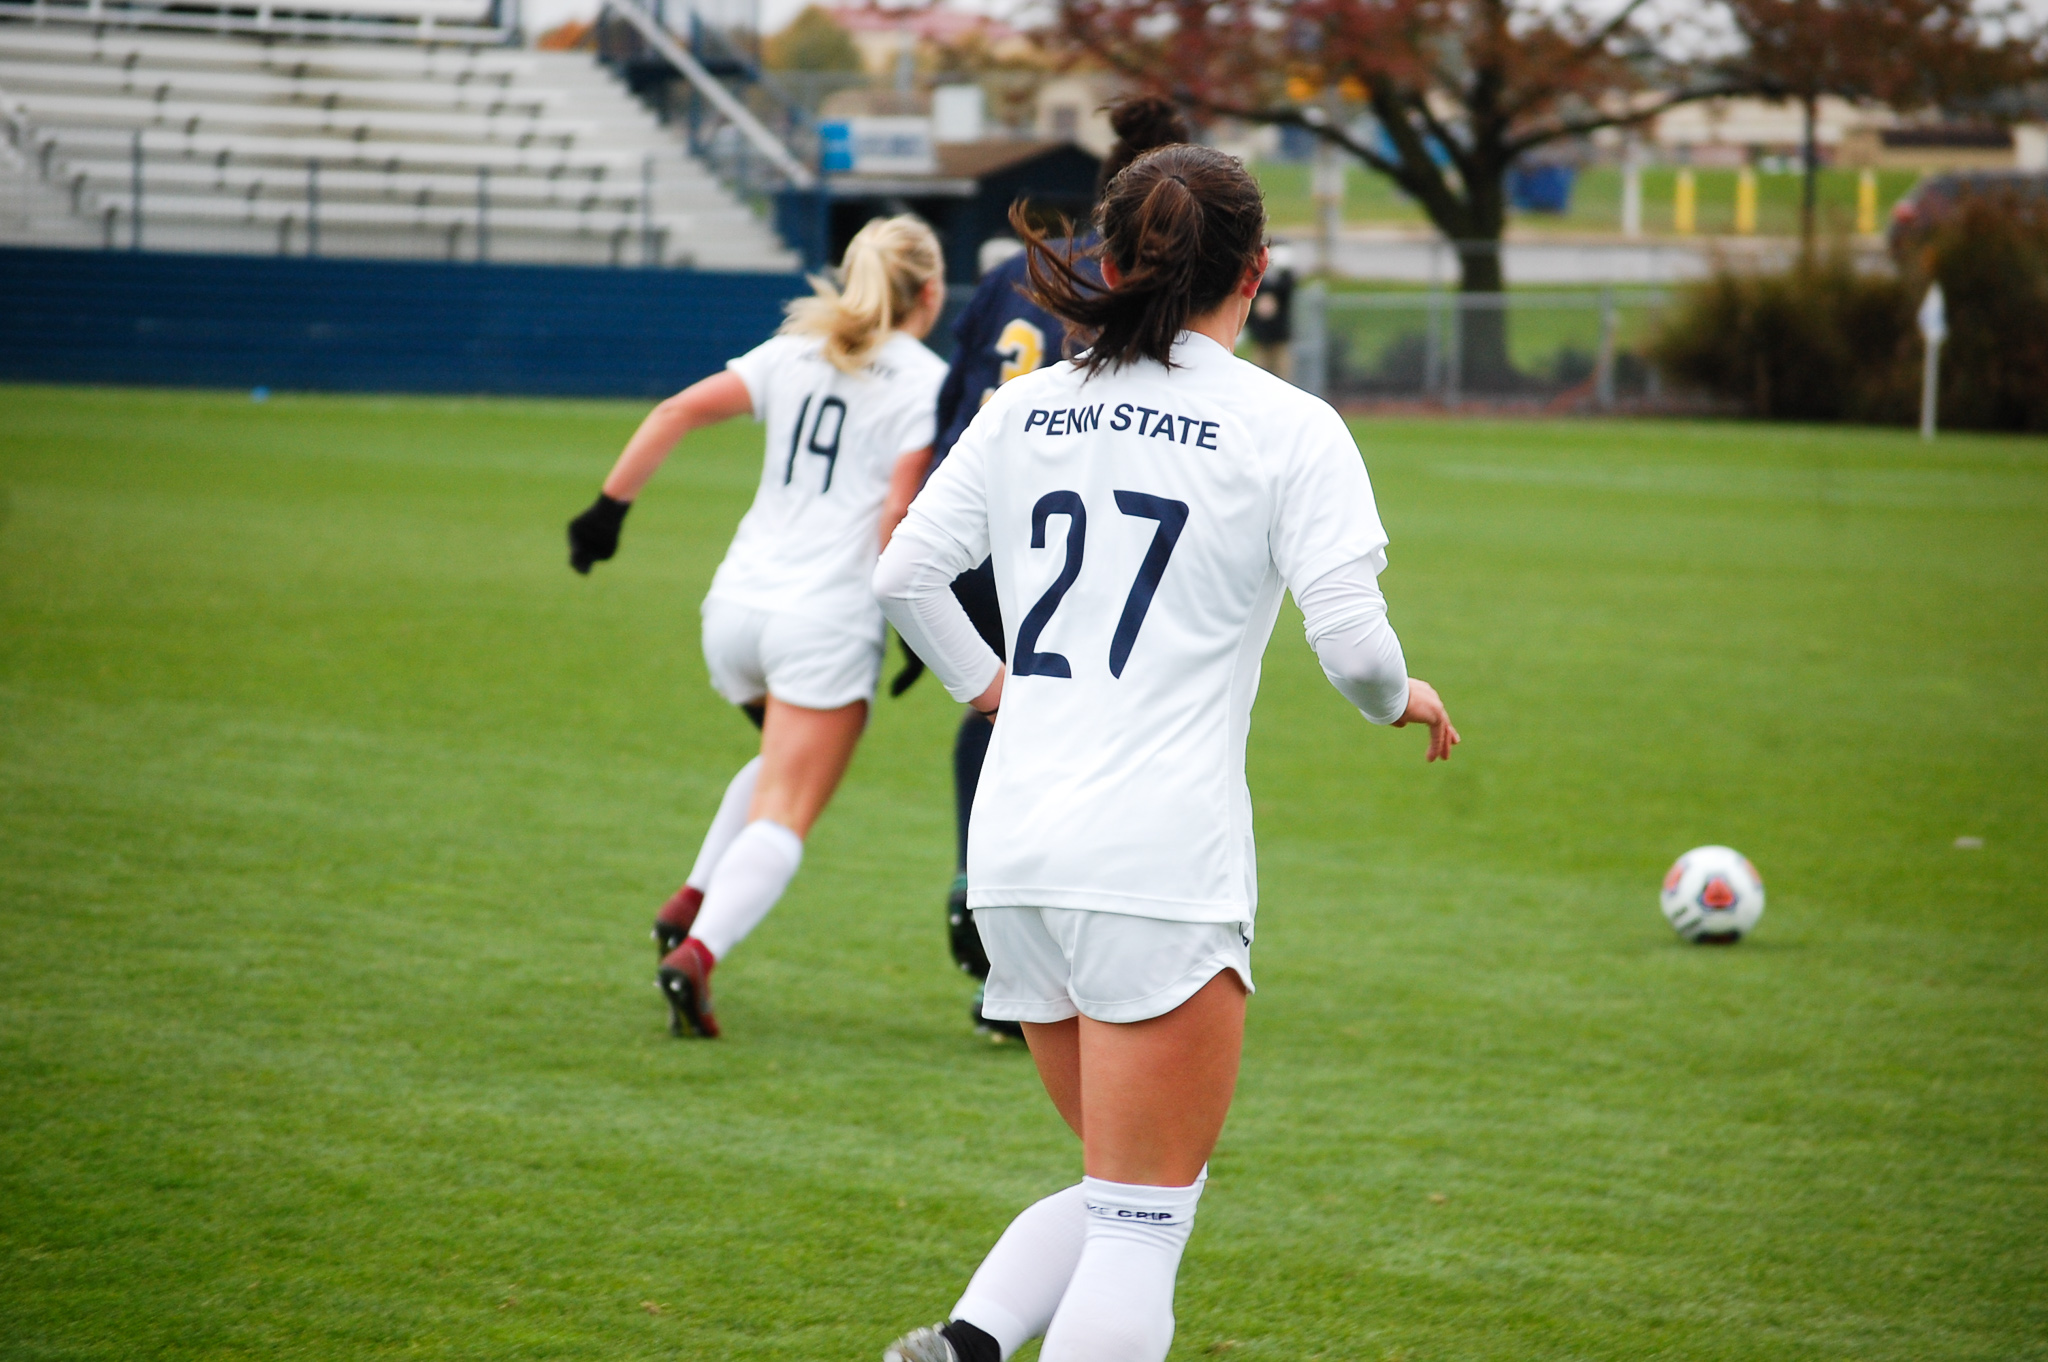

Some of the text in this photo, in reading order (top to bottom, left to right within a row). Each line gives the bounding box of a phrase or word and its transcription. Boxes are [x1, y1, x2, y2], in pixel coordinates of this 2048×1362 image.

[784, 393, 847, 494] 19
[1024, 403, 1220, 450] PENN STATE
[1012, 490, 1189, 679] 27
